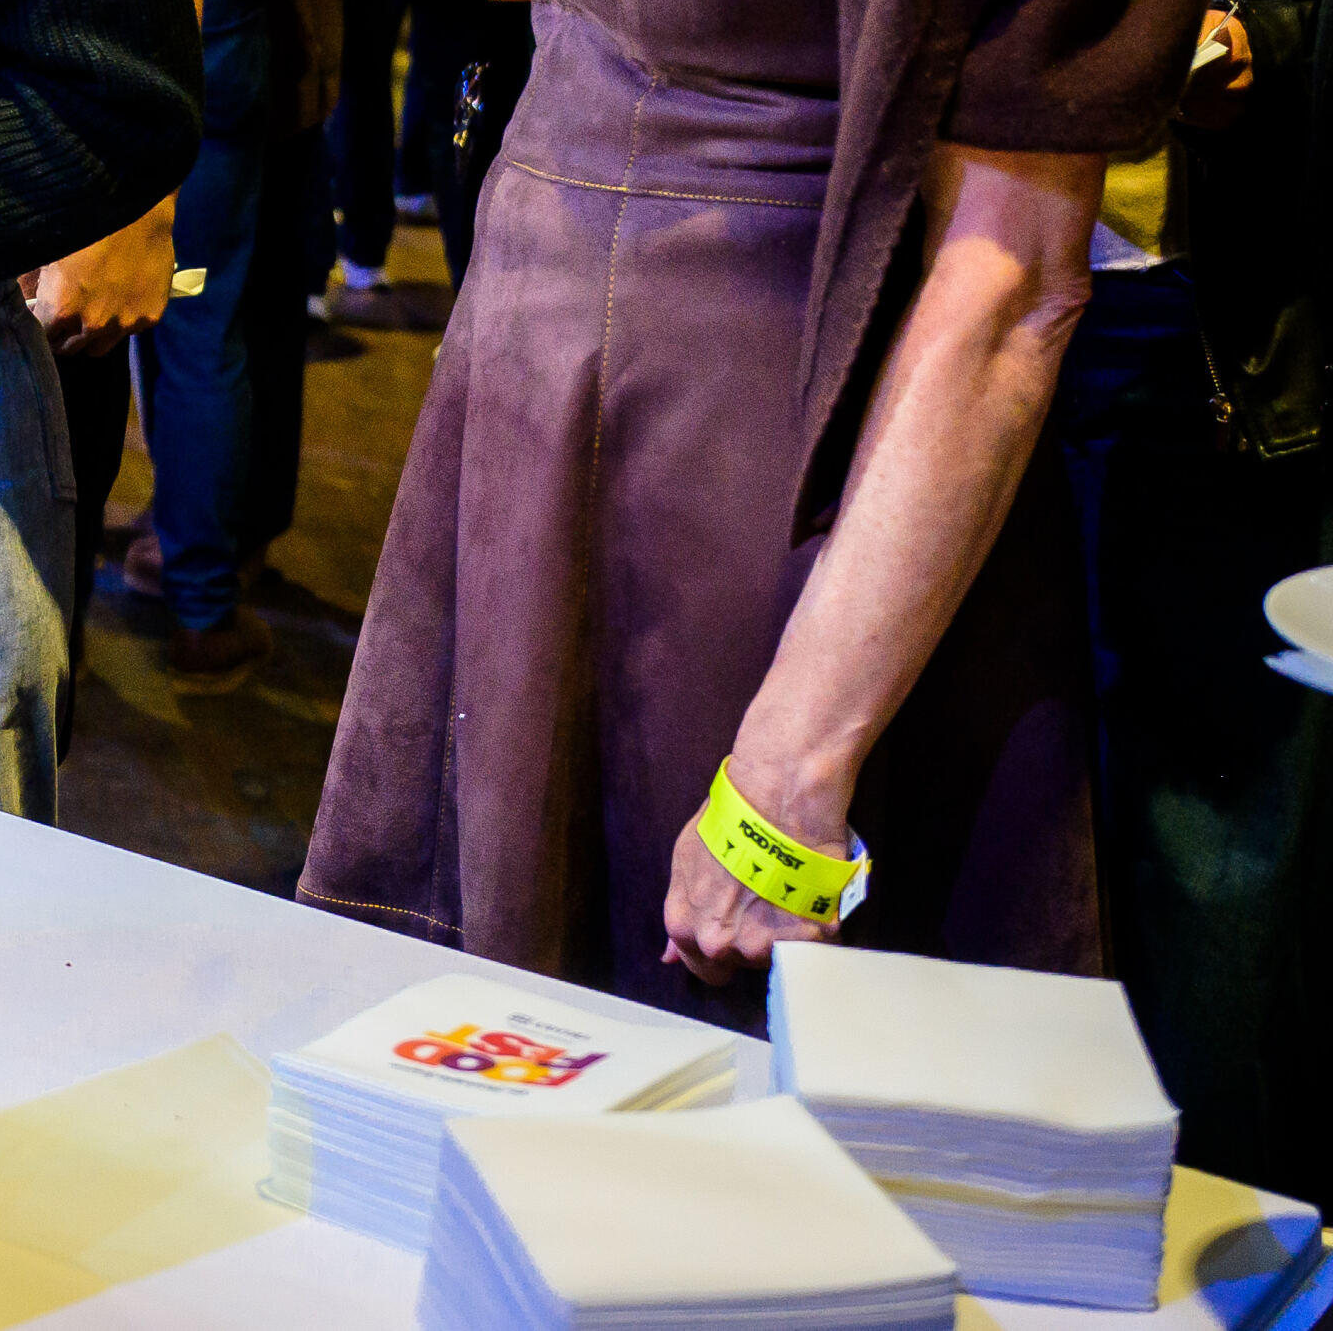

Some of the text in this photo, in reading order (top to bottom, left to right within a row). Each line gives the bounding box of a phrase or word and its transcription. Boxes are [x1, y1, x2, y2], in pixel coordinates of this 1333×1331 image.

[739, 819, 769, 850] FOOD
[767, 844, 805, 871] FEST
[393, 1038, 583, 1088] FOOD
[424, 1023, 609, 1070] FEST
